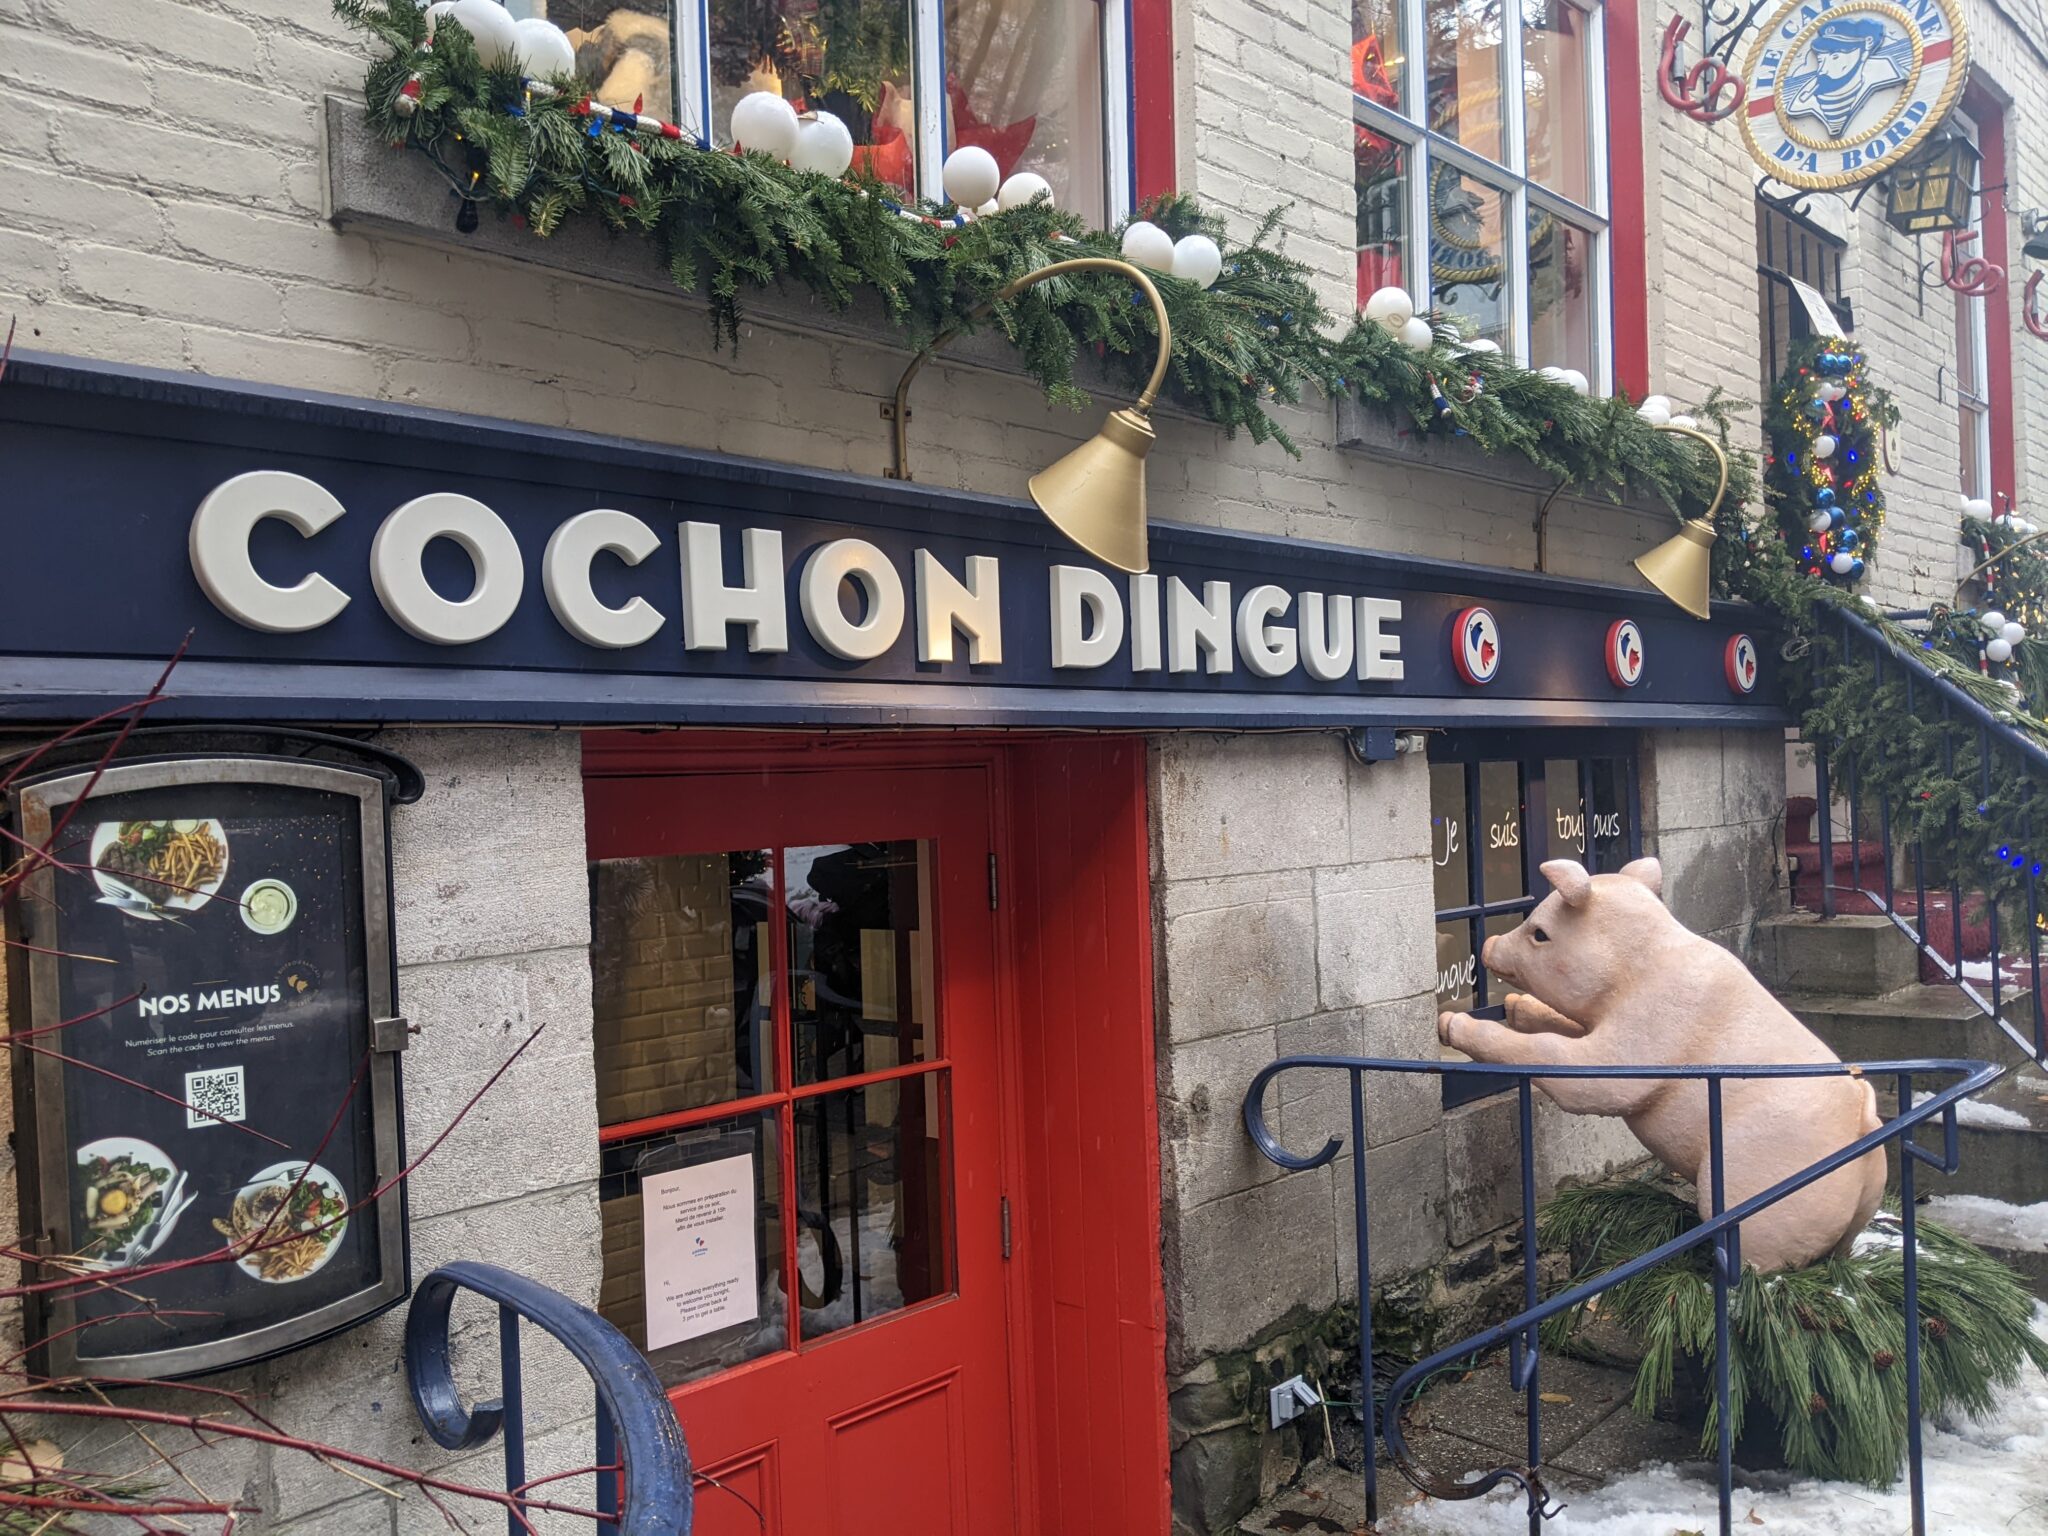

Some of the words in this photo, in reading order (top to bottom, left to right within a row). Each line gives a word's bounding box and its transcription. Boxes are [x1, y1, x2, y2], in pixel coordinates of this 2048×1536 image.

[1756, 50, 1783, 88] LE
[1841, 101, 1927, 172] BORD
[188, 470, 1003, 665] COCHON
[1049, 564, 1404, 682] DINGUE
[1490, 812, 1518, 849] suis
[139, 994, 190, 1017] NOS
[197, 984, 281, 1011] MENUS
[125, 1036, 167, 1048] Numériser
[169, 1033, 176, 1042] le
[178, 1031, 198, 1041] code
[199, 1030, 218, 1041] pour
[220, 1025, 255, 1036] consulter
[256, 1023, 267, 1031] les
[268, 1021, 295, 1030] menus.
[146, 1045, 168, 1056] Scan
[169, 1043, 182, 1053] the
[184, 1040, 204, 1051] code
[206, 1040, 215, 1049] to
[216, 1038, 234, 1048] view
[236, 1035, 248, 1045] the
[250, 1034, 276, 1044] menus.
[677, 1199, 696, 1207] sommes
[680, 1206, 696, 1214] service
[677, 1224, 685, 1232] afin
[685, 1288, 701, 1297] making
[702, 1281, 726, 1291] everything
[680, 1306, 696, 1314] Please
[682, 1296, 703, 1305] welcome
